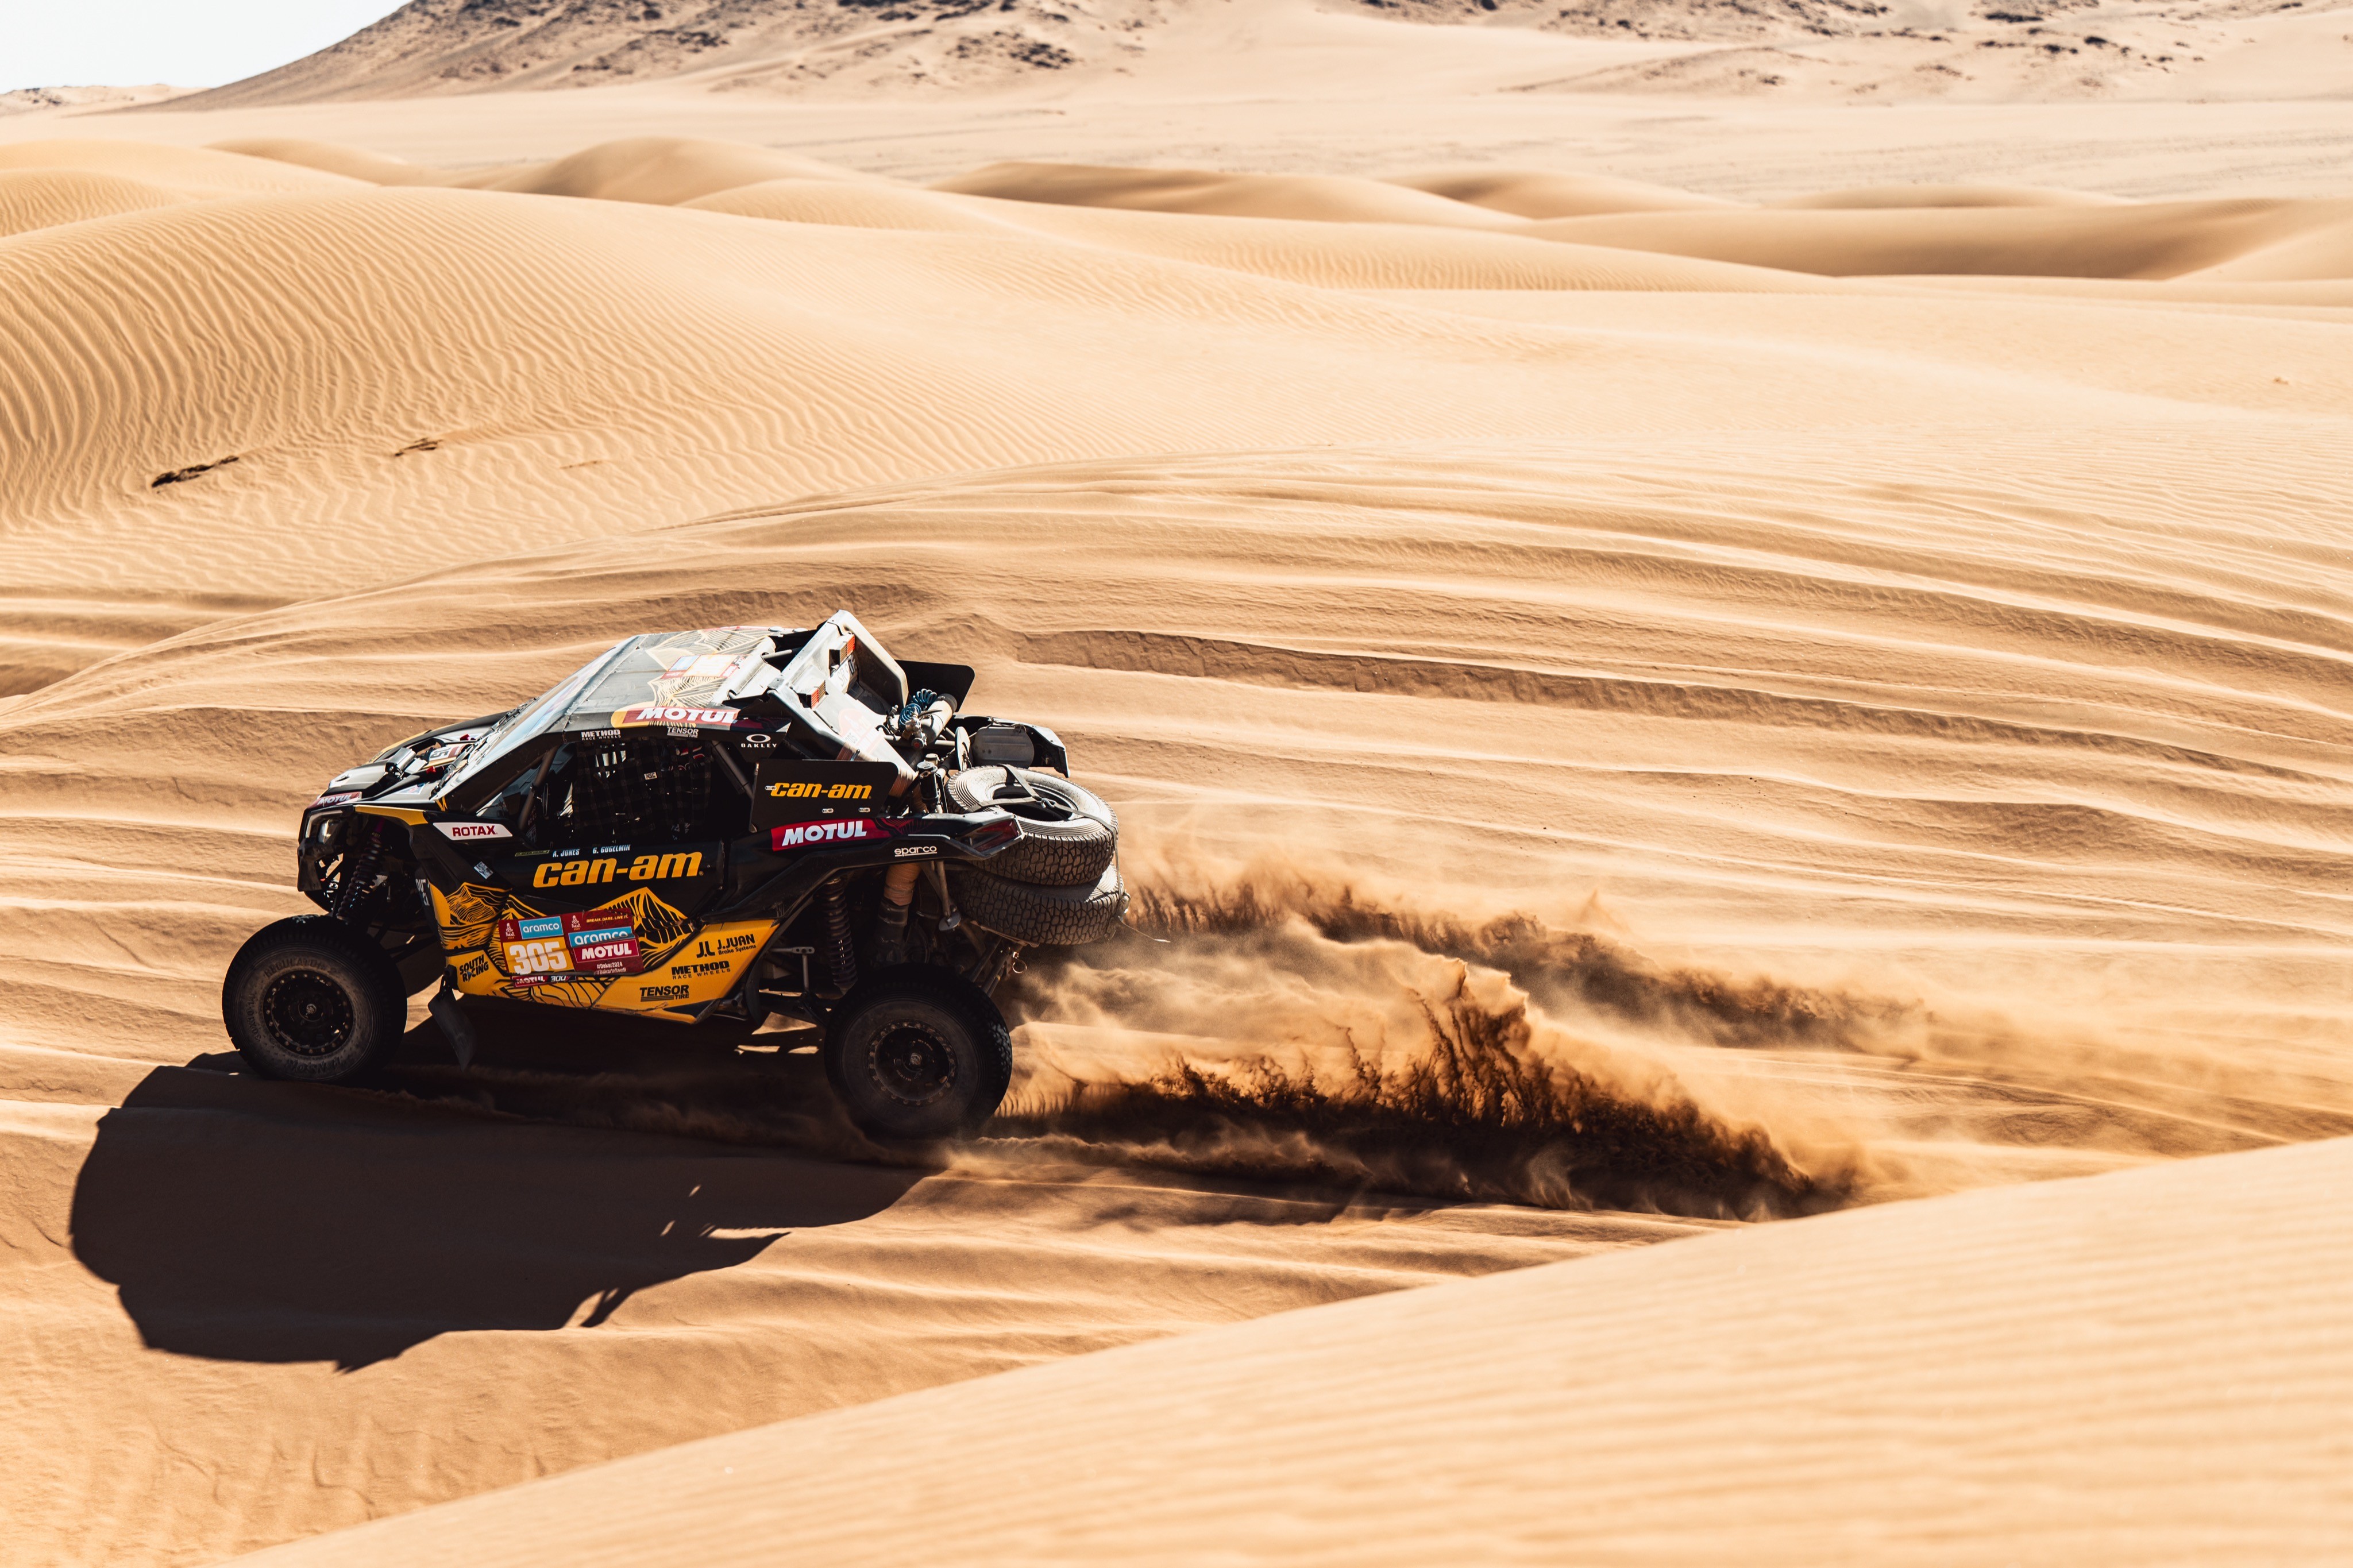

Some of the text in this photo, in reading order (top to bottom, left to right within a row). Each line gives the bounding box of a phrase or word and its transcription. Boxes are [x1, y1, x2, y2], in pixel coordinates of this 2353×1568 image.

[636, 707, 738, 724] MOTUL
[581, 729, 621, 738] METHOD
[667, 727, 699, 735] TENSOR
[770, 782, 872, 799] can-am
[317, 794, 352, 805] MOTUL
[452, 825, 495, 837] ROTAX
[782, 821, 867, 847] MOTUL
[560, 849, 580, 857] JONES
[600, 844, 631, 853] GUGELMIN
[894, 846, 937, 856] sparco
[533, 851, 702, 888] can-am
[523, 923, 560, 933] aramco
[574, 930, 629, 945] aramco
[717, 934, 755, 950] J.JUAN
[581, 943, 632, 960] MOTUL
[735, 944, 757, 952] Systems
[459, 954, 484, 975] SOUTH
[510, 941, 568, 975] 305
[671, 960, 730, 975] METHOD
[696, 968, 731, 977] WHEELS
[639, 984, 689, 997] TENSOR
